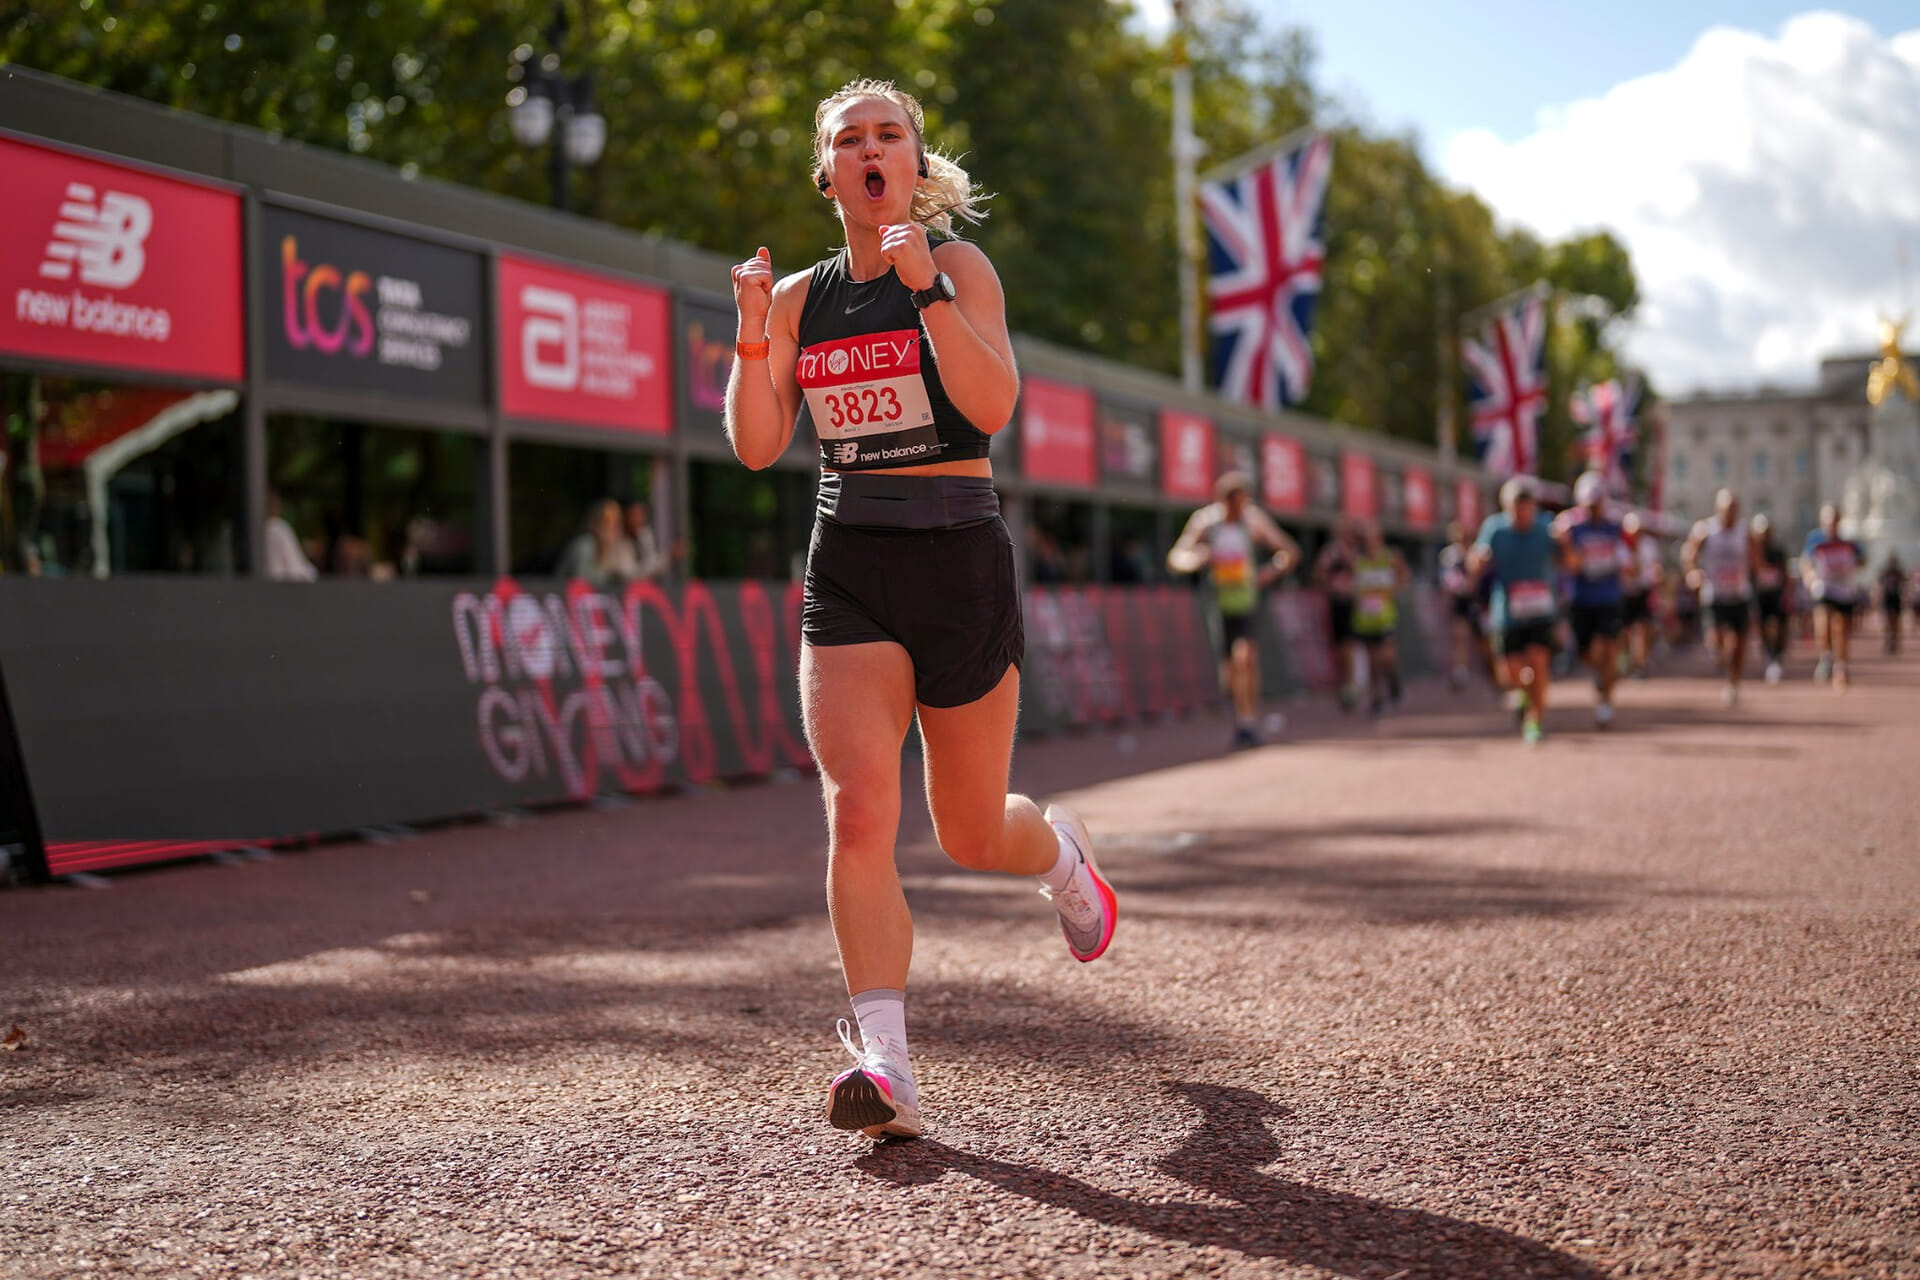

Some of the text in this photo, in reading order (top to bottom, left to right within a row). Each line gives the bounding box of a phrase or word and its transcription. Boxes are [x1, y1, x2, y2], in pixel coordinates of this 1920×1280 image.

[16, 288, 171, 342] new balance
[281, 235, 374, 356] tcs
[825, 386, 903, 429] 3823
[860, 443, 927, 462] new balance
